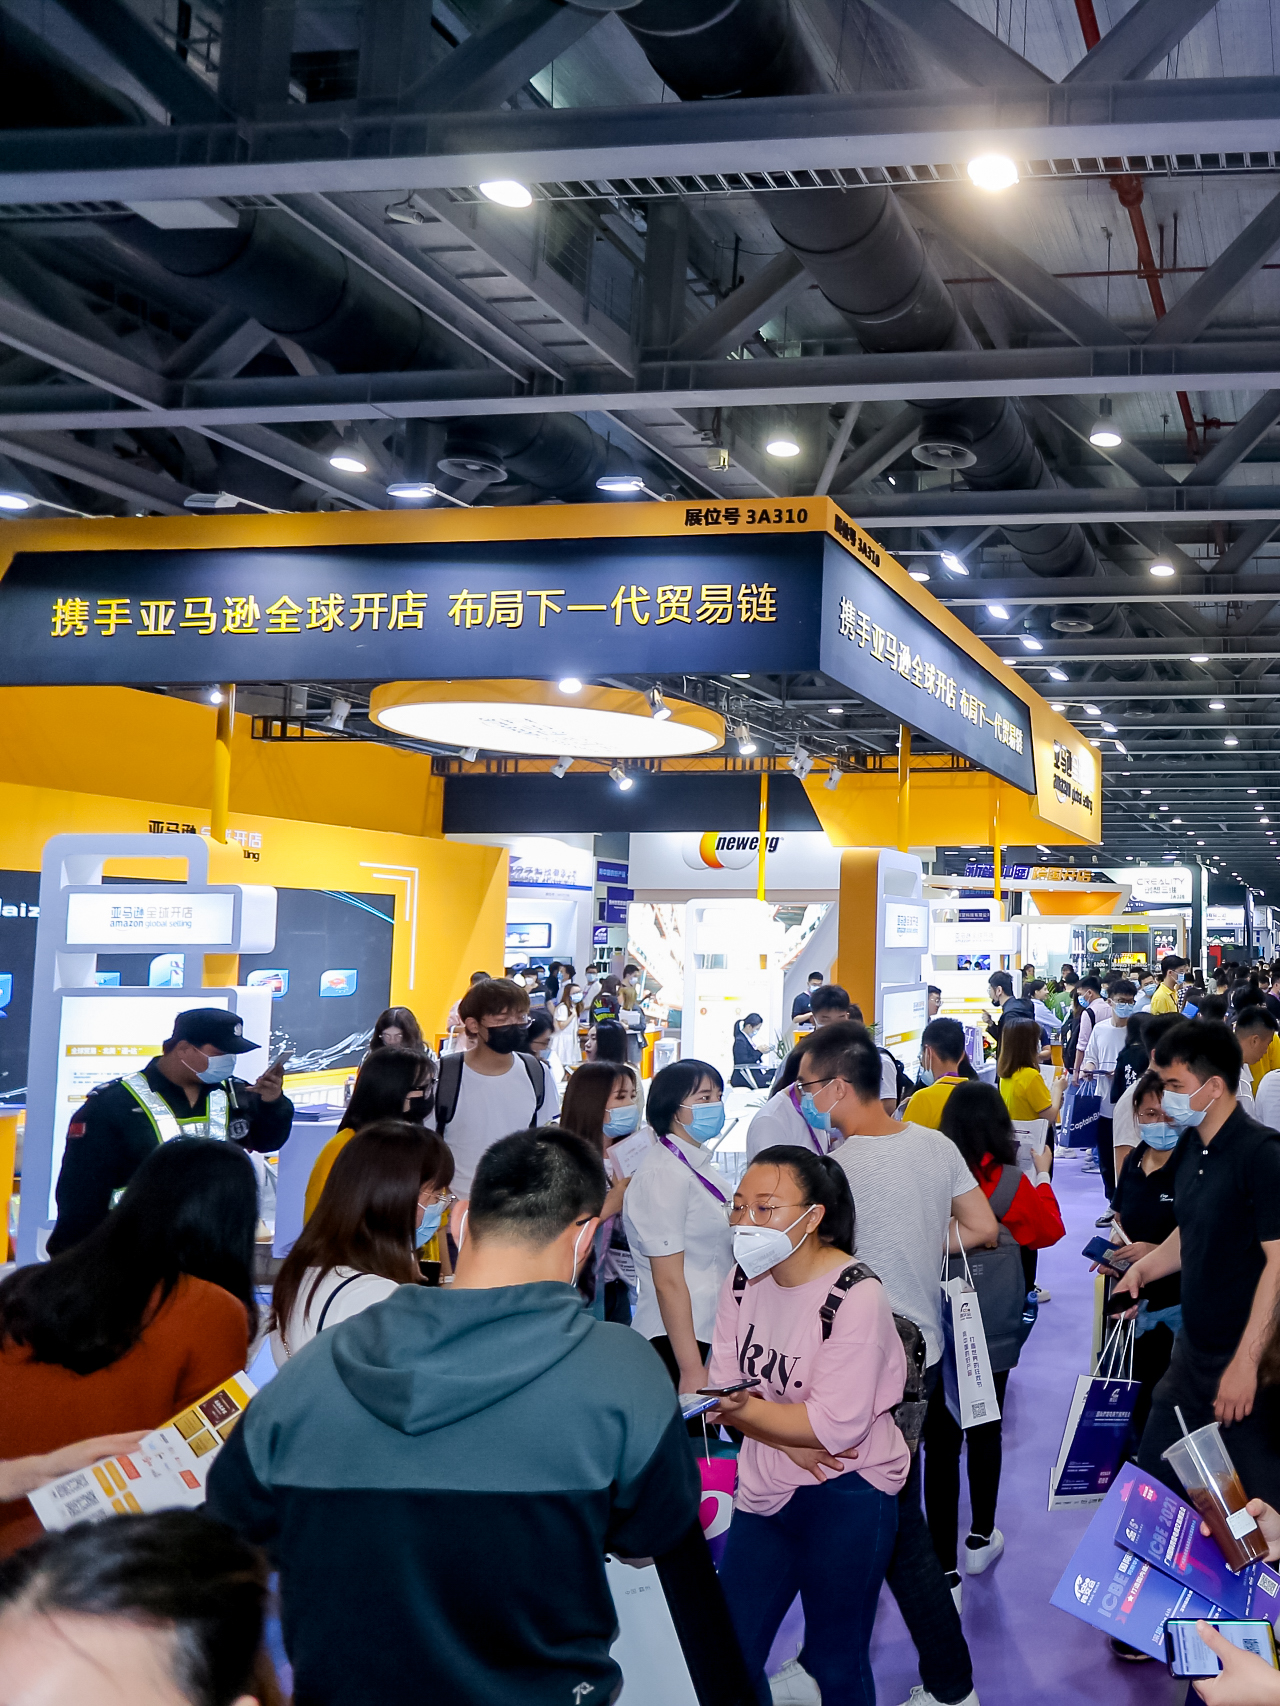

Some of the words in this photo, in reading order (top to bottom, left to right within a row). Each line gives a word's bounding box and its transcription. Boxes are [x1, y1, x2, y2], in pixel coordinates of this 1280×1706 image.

[684, 508, 741, 527] 展位号
[746, 508, 808, 525] 3A310
[50, 590, 428, 638] 携手亚马逊全球开店
[448, 582, 778, 629] 布局下一代贸易链
[839, 596, 957, 712] 携手亚马逊全球开店
[959, 688, 1024, 756] 布局下一代贸易链
[1136, 878, 1185, 886] CREALITY
[110, 920, 143, 928] amazon
[111, 906, 193, 919] 亚马逊全球开店
[736, 1322, 803, 1396] kay.
[1097, 1571, 1130, 1618] ICBE
